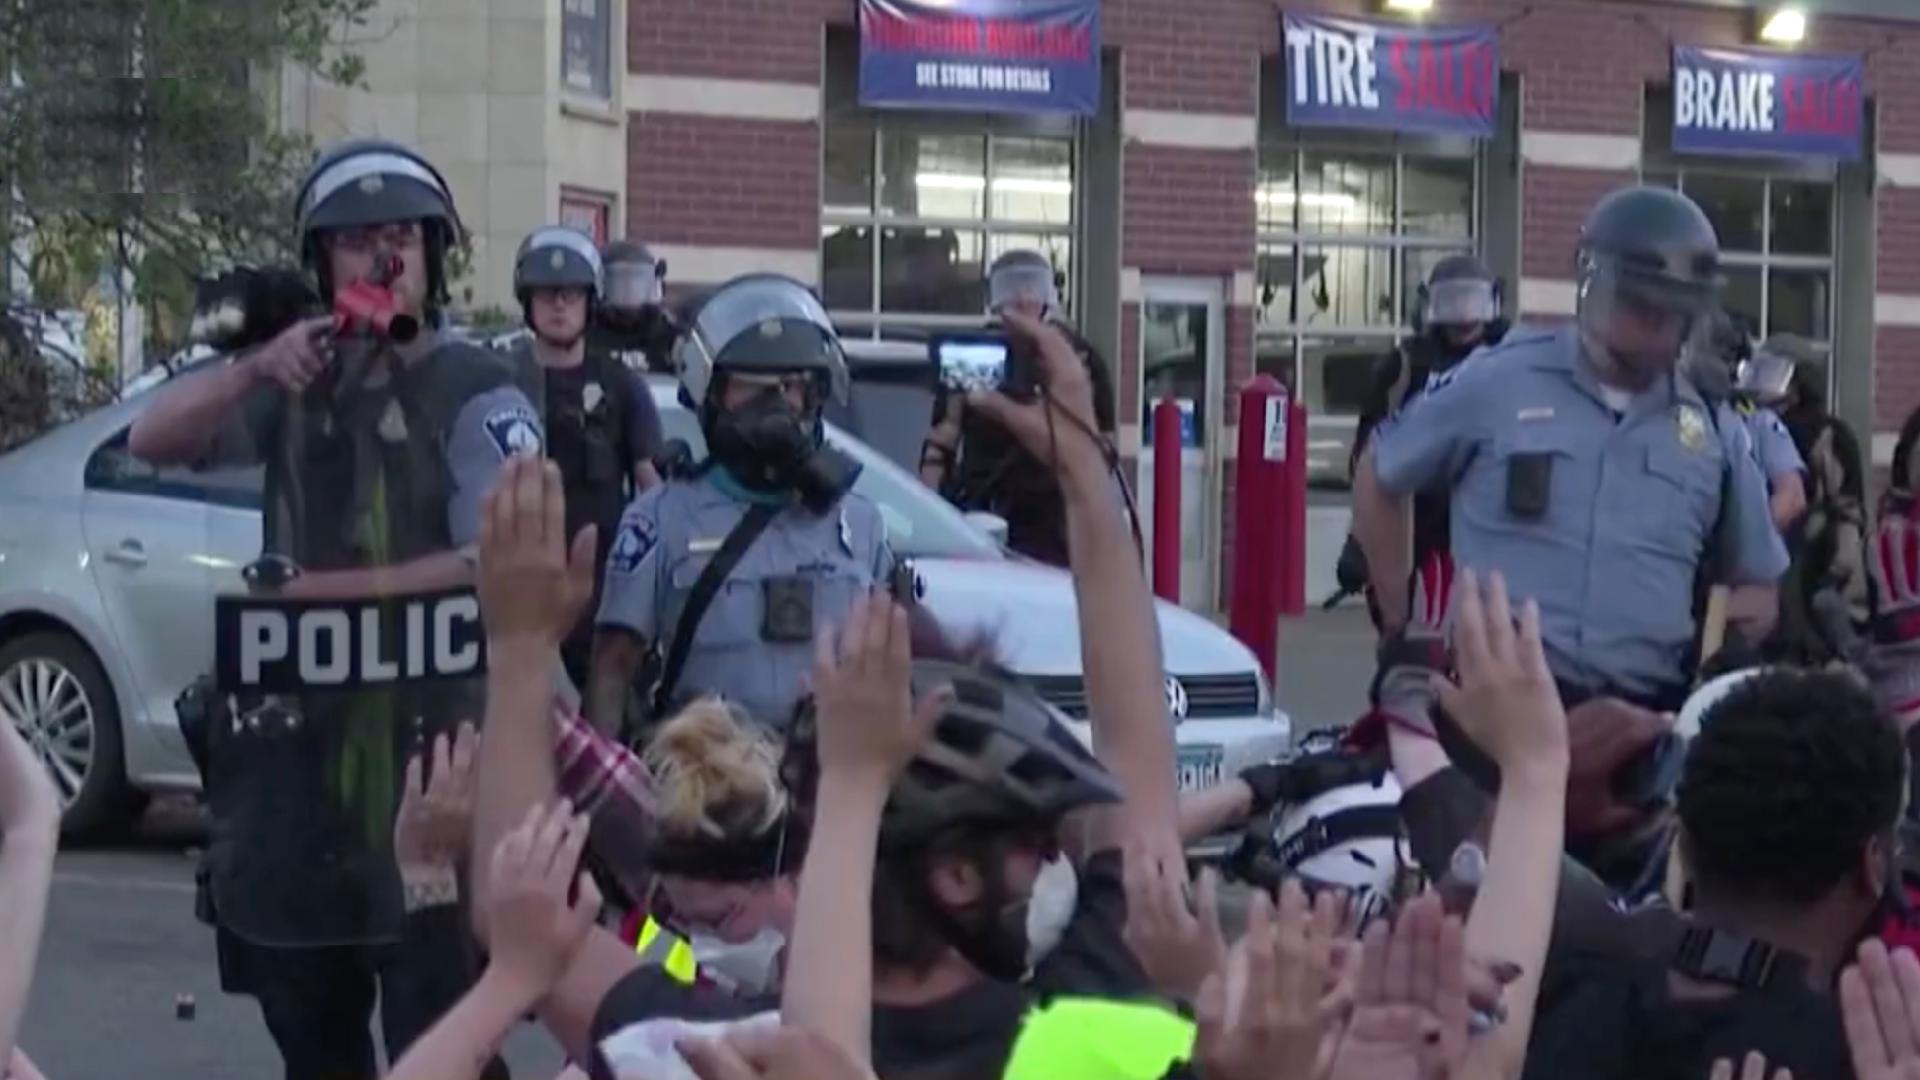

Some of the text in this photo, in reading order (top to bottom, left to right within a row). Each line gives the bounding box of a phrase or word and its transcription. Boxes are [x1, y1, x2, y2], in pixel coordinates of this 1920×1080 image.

[1286, 27, 1379, 109] TIRE
[1676, 67, 1775, 132] BRAKE
[240, 595, 479, 684] POLIC
